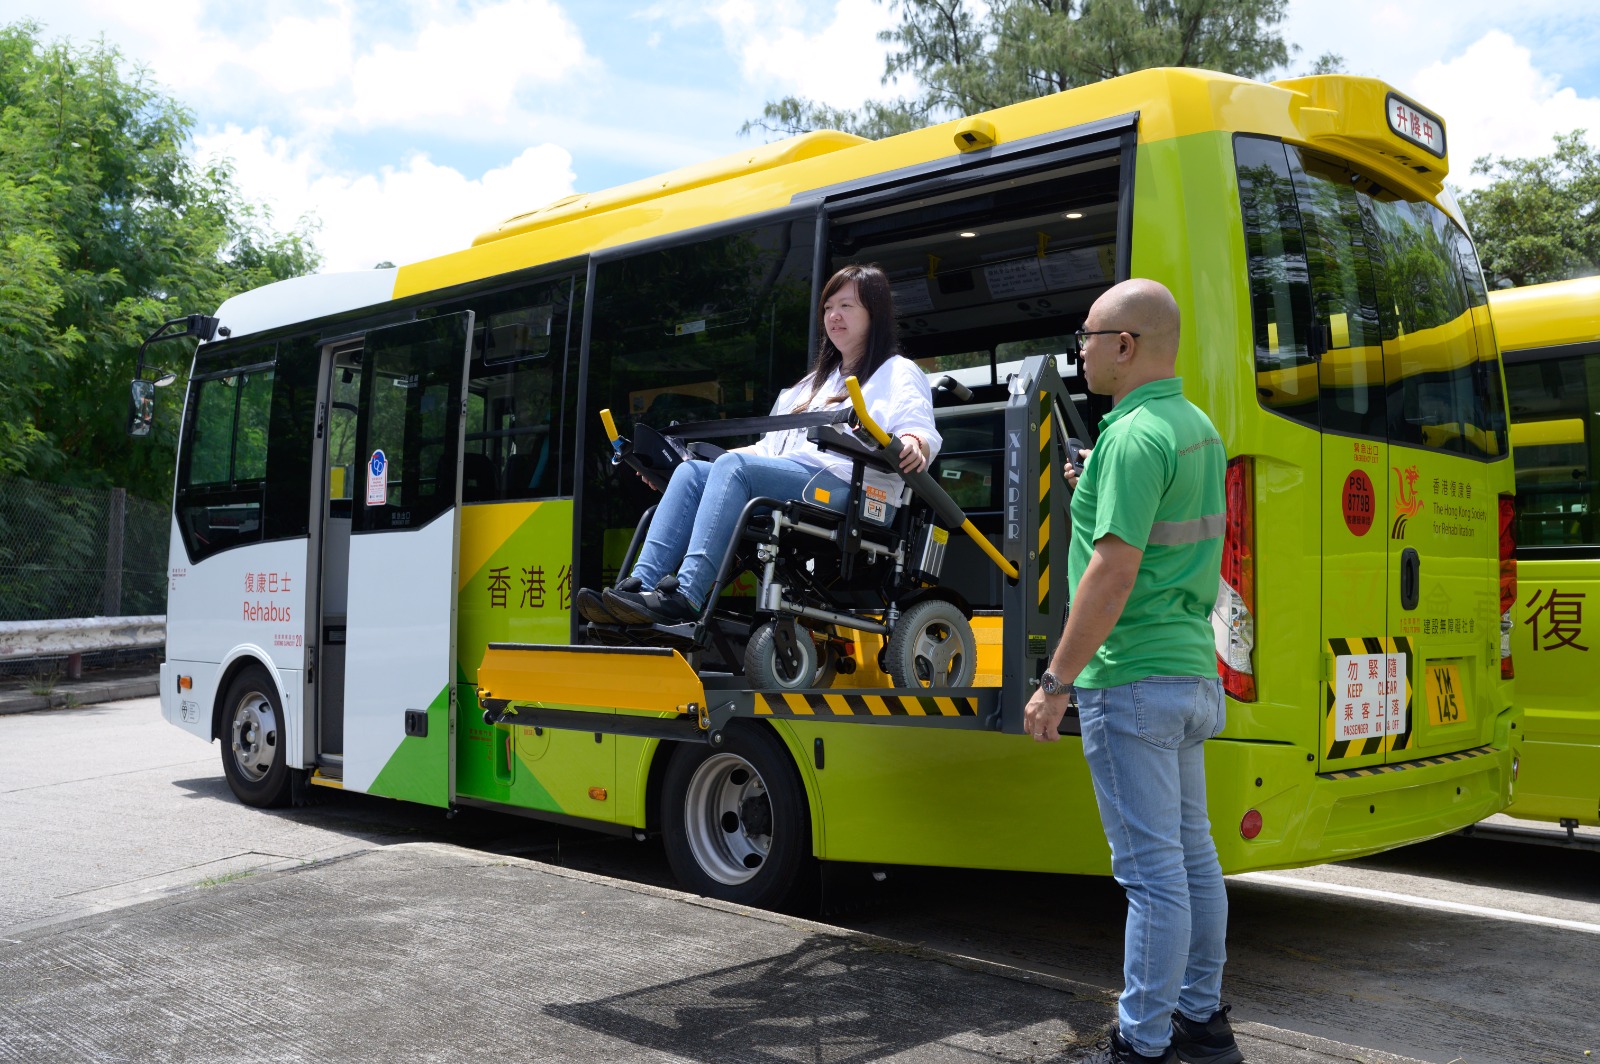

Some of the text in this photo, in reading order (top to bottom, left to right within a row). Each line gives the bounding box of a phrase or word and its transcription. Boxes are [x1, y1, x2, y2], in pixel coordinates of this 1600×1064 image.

[1397, 106, 1433, 144] 升降中
[1008, 433, 1020, 539] XINDER
[1349, 476, 1367, 491] PSL
[1347, 493, 1370, 512] 8779B
[1433, 502, 1487, 522] The Hong Kong Society
[1433, 520, 1475, 537] for Rehabilitation
[244, 572, 291, 593] 復康巴士
[243, 601, 291, 622] Rehabus
[1524, 588, 1589, 652] 復
[1347, 658, 1397, 681] 勿緊隨
[1347, 681, 1397, 698] KEEP CLEAR
[1434, 667, 1453, 695] YM
[1344, 699, 1399, 721] 乘客上落
[1437, 694, 1458, 722] 145
[1344, 723, 1368, 736] PASSENGER
[1376, 722, 1382, 732] ON
